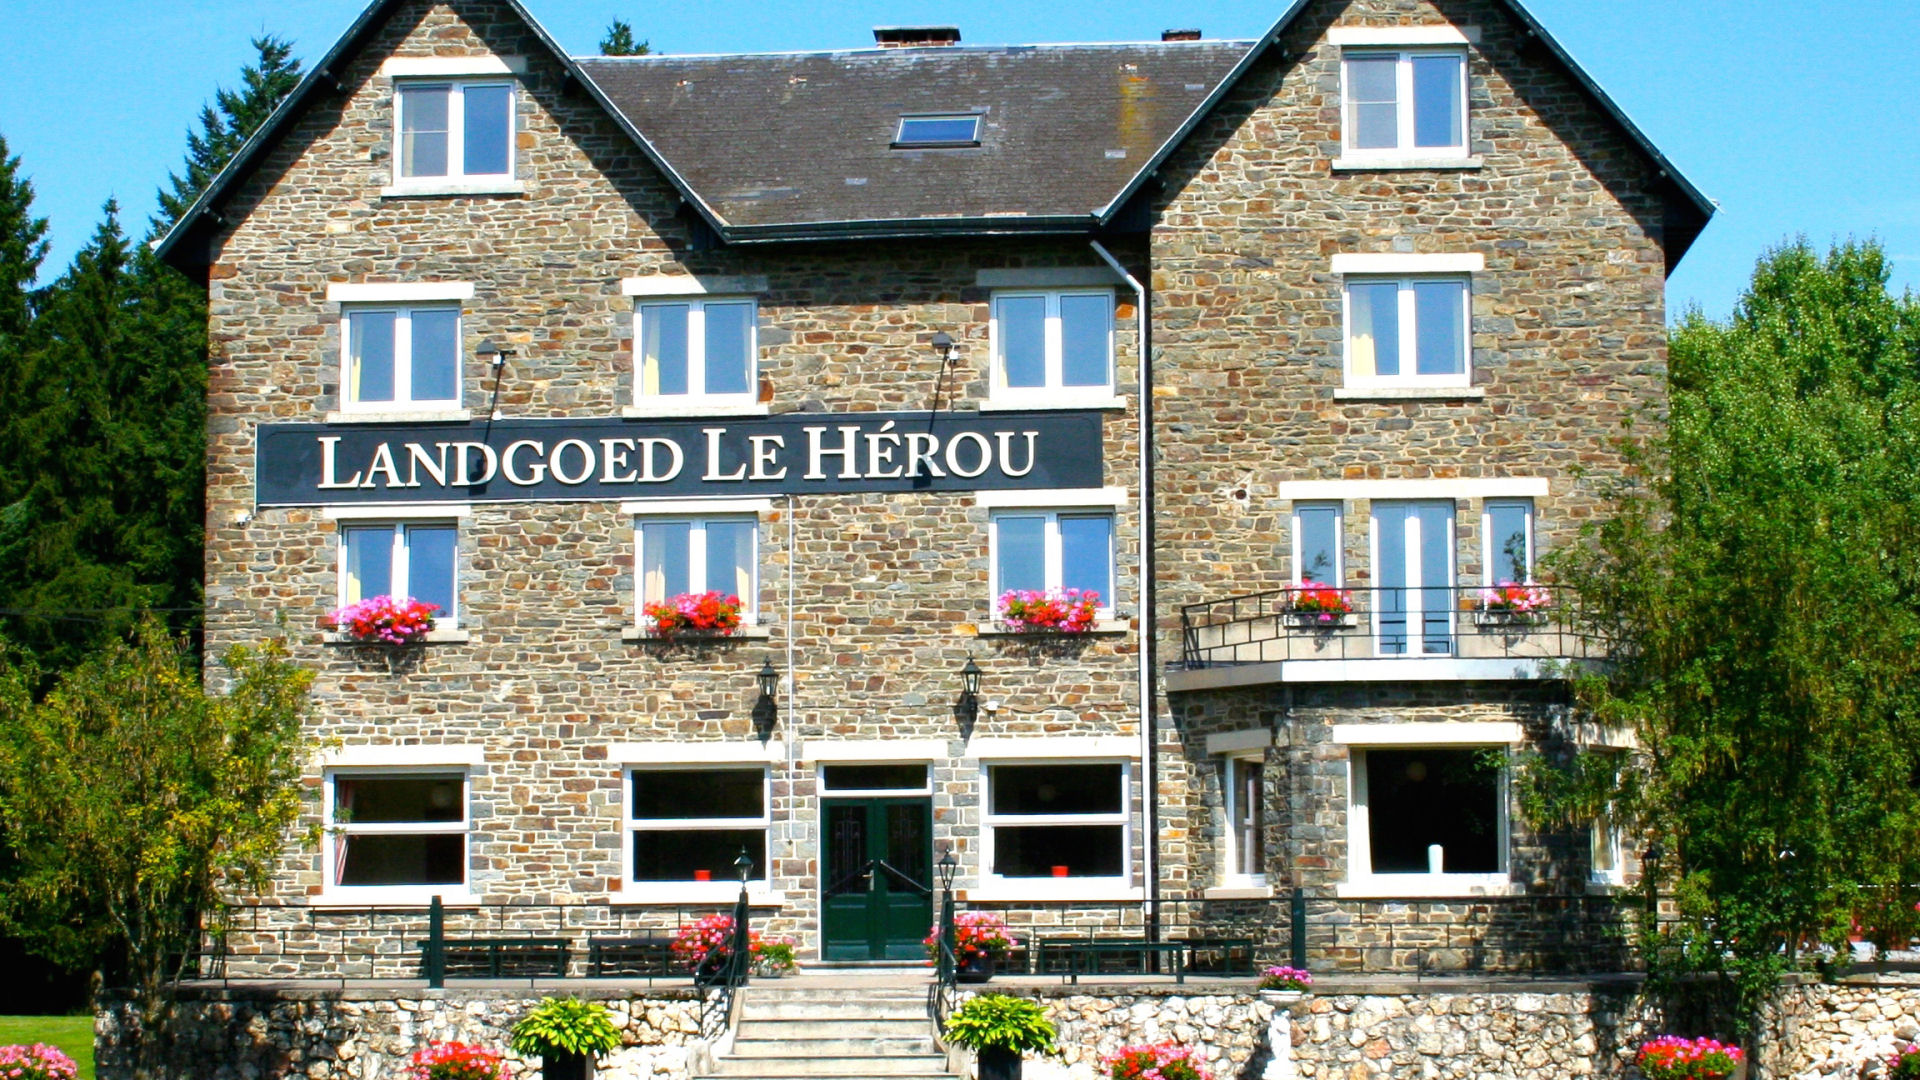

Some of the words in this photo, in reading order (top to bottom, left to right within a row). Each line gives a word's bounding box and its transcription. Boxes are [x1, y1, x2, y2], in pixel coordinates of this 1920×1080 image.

[317, 436, 684, 489] LANDGOED
[702, 428, 788, 481] LE
[802, 420, 1039, 480] HÉROU
